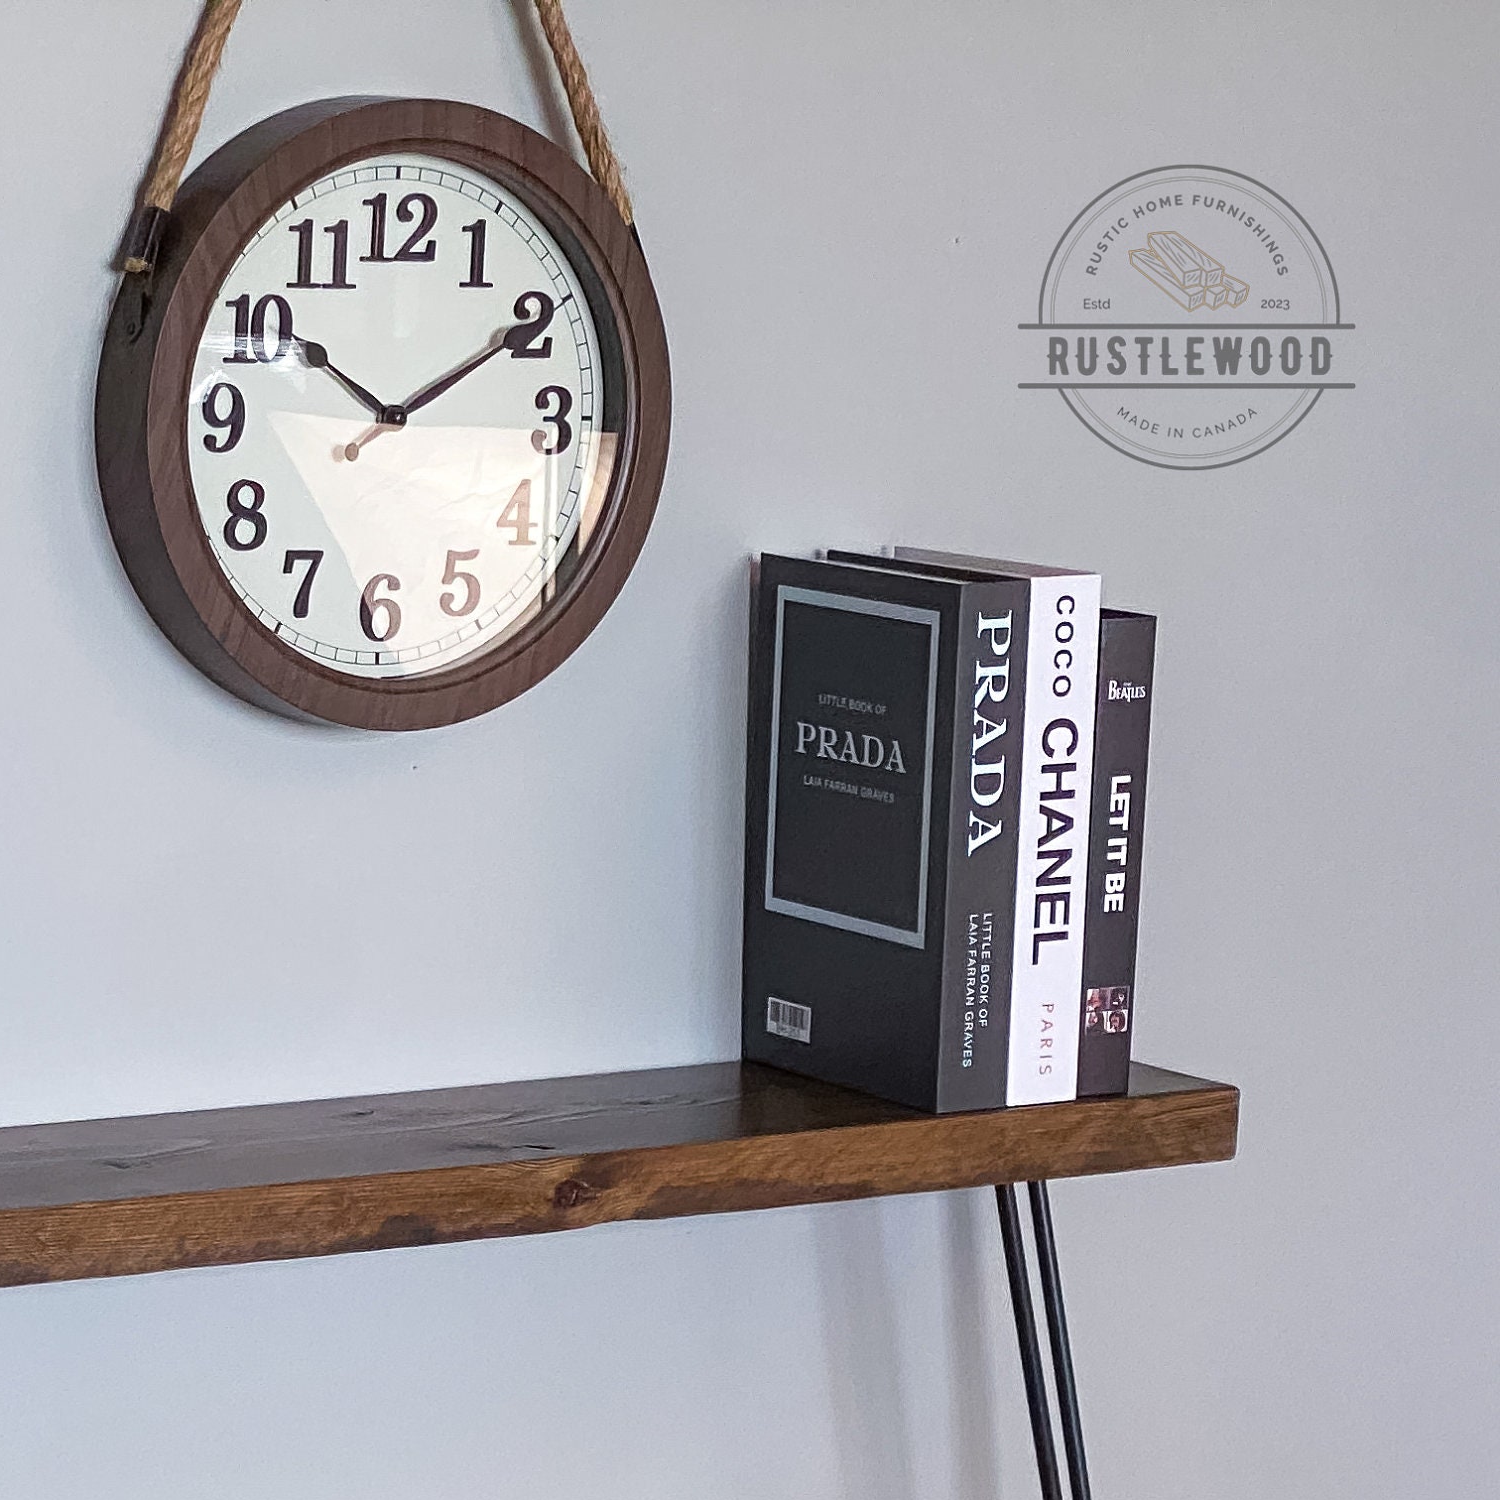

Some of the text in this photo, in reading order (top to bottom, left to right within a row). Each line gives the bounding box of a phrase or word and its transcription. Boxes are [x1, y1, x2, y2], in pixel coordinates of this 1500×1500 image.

[286, 219, 356, 289] 11
[359, 193, 438, 262] 12
[459, 219, 494, 288] 1
[223, 294, 293, 364] 10
[509, 291, 554, 358] 2
[202, 383, 245, 453] 9
[531, 385, 572, 455] 3
[223, 479, 267, 551] 8
[496, 479, 537, 546] 4
[283, 550, 324, 618] 7
[360, 573, 401, 642] 6
[439, 549, 480, 617] 5
[819, 693, 887, 715] LITTLE BOOK OF
[968, 609, 1014, 857] PRADA
[794, 721, 907, 774] PRADA
[1032, 594, 1079, 966] COCO CHANEL
[860, 786, 895, 803] GRAVES
[1103, 775, 1132, 913] LET IT BE
[962, 914, 979, 1068] LAIA FARRAN GRAVES
[978, 913, 993, 1027] LITTLE BOOK OF
[1039, 1003, 1055, 1075] PARIS
